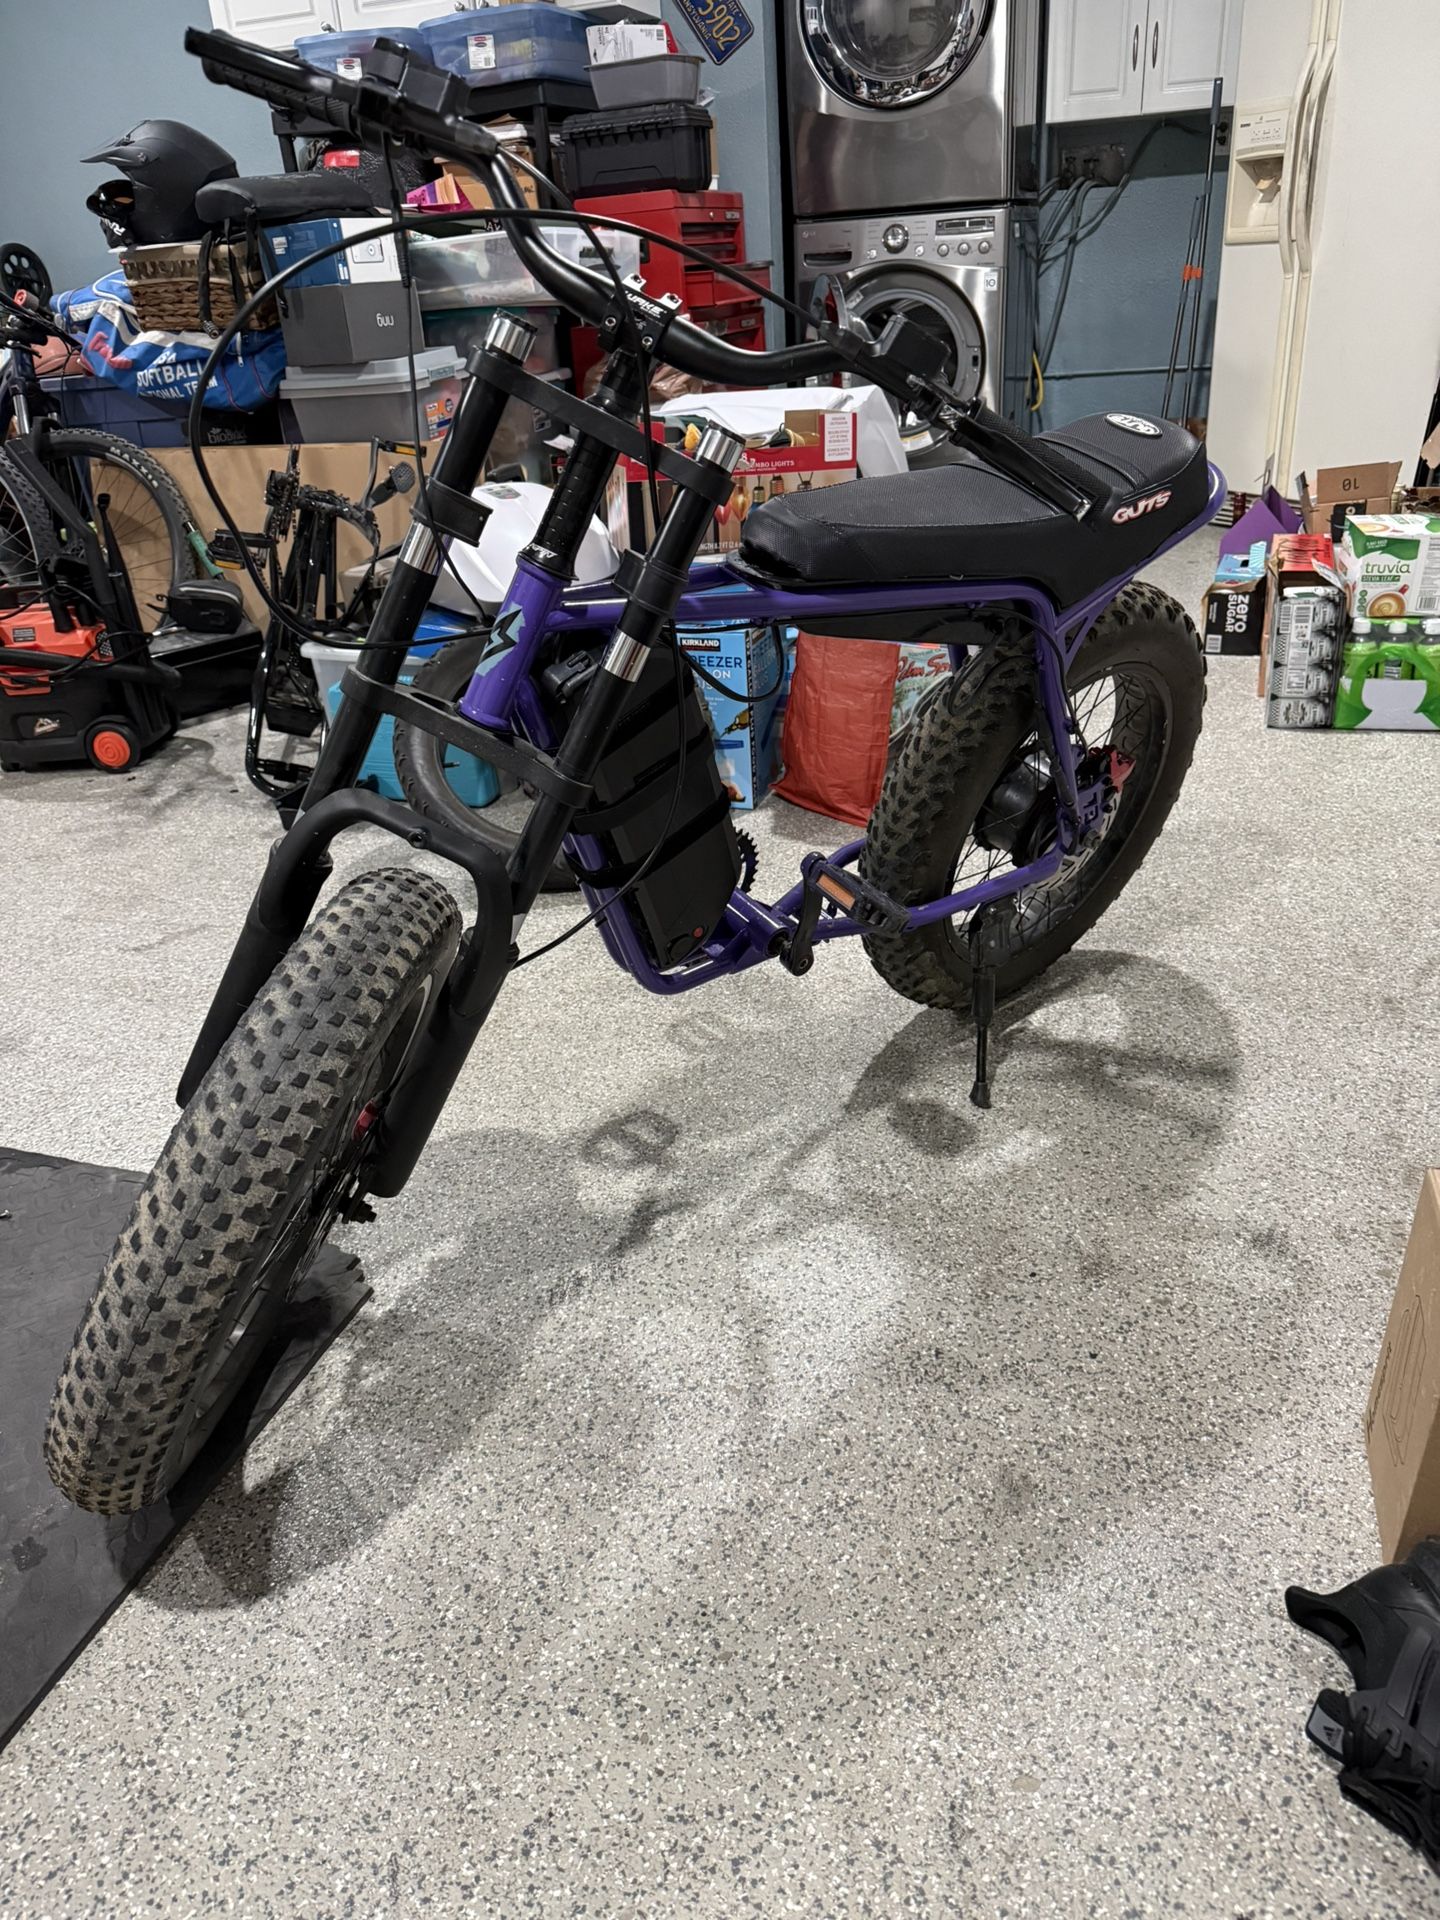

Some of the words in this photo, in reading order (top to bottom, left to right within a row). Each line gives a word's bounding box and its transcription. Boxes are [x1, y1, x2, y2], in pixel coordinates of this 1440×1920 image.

[185, 375, 218, 396] TEM
[1112, 490, 1172, 525] GUTS
[1224, 594, 1237, 633] SUGAR
[681, 639, 720, 647] KIRKLAND
